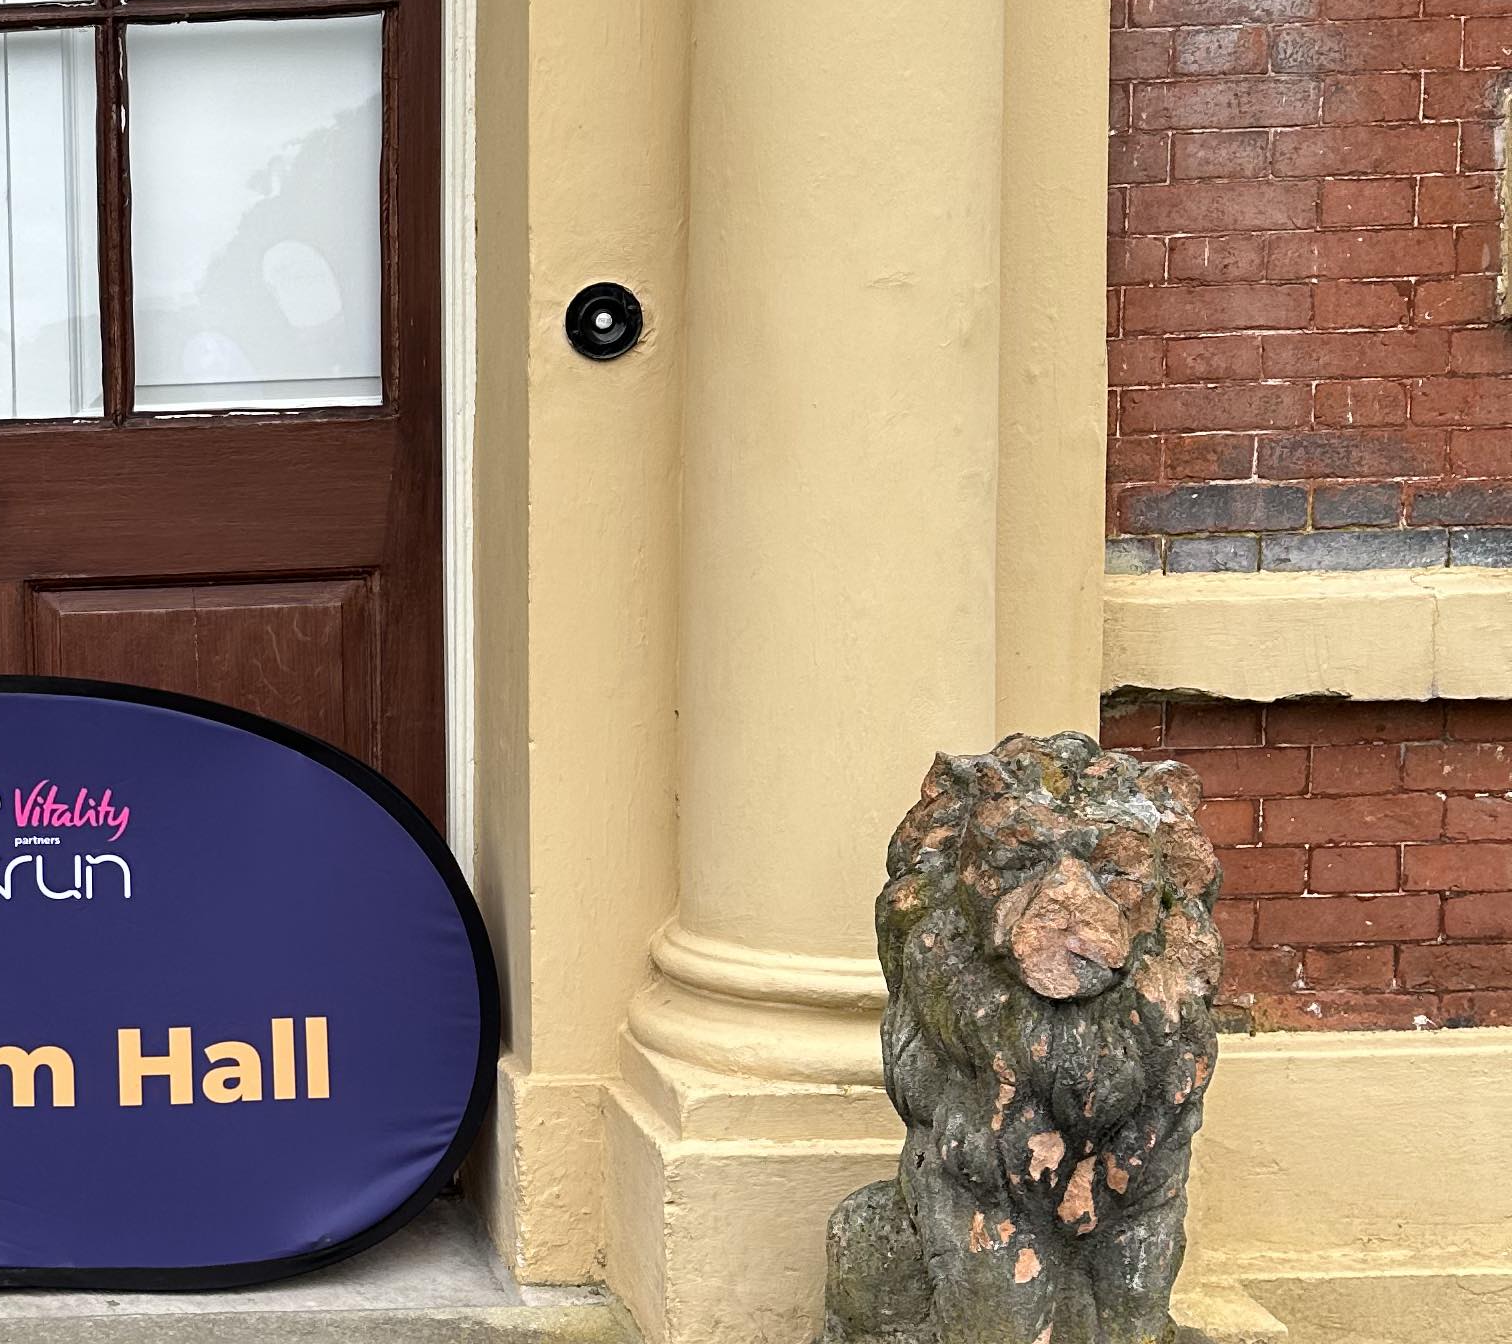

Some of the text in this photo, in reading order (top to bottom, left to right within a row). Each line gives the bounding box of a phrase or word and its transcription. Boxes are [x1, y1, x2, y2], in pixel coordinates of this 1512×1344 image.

[14, 779, 130, 842] Vitality
[14, 835, 61, 848] partners
[117, 1016, 330, 1107] Hall
